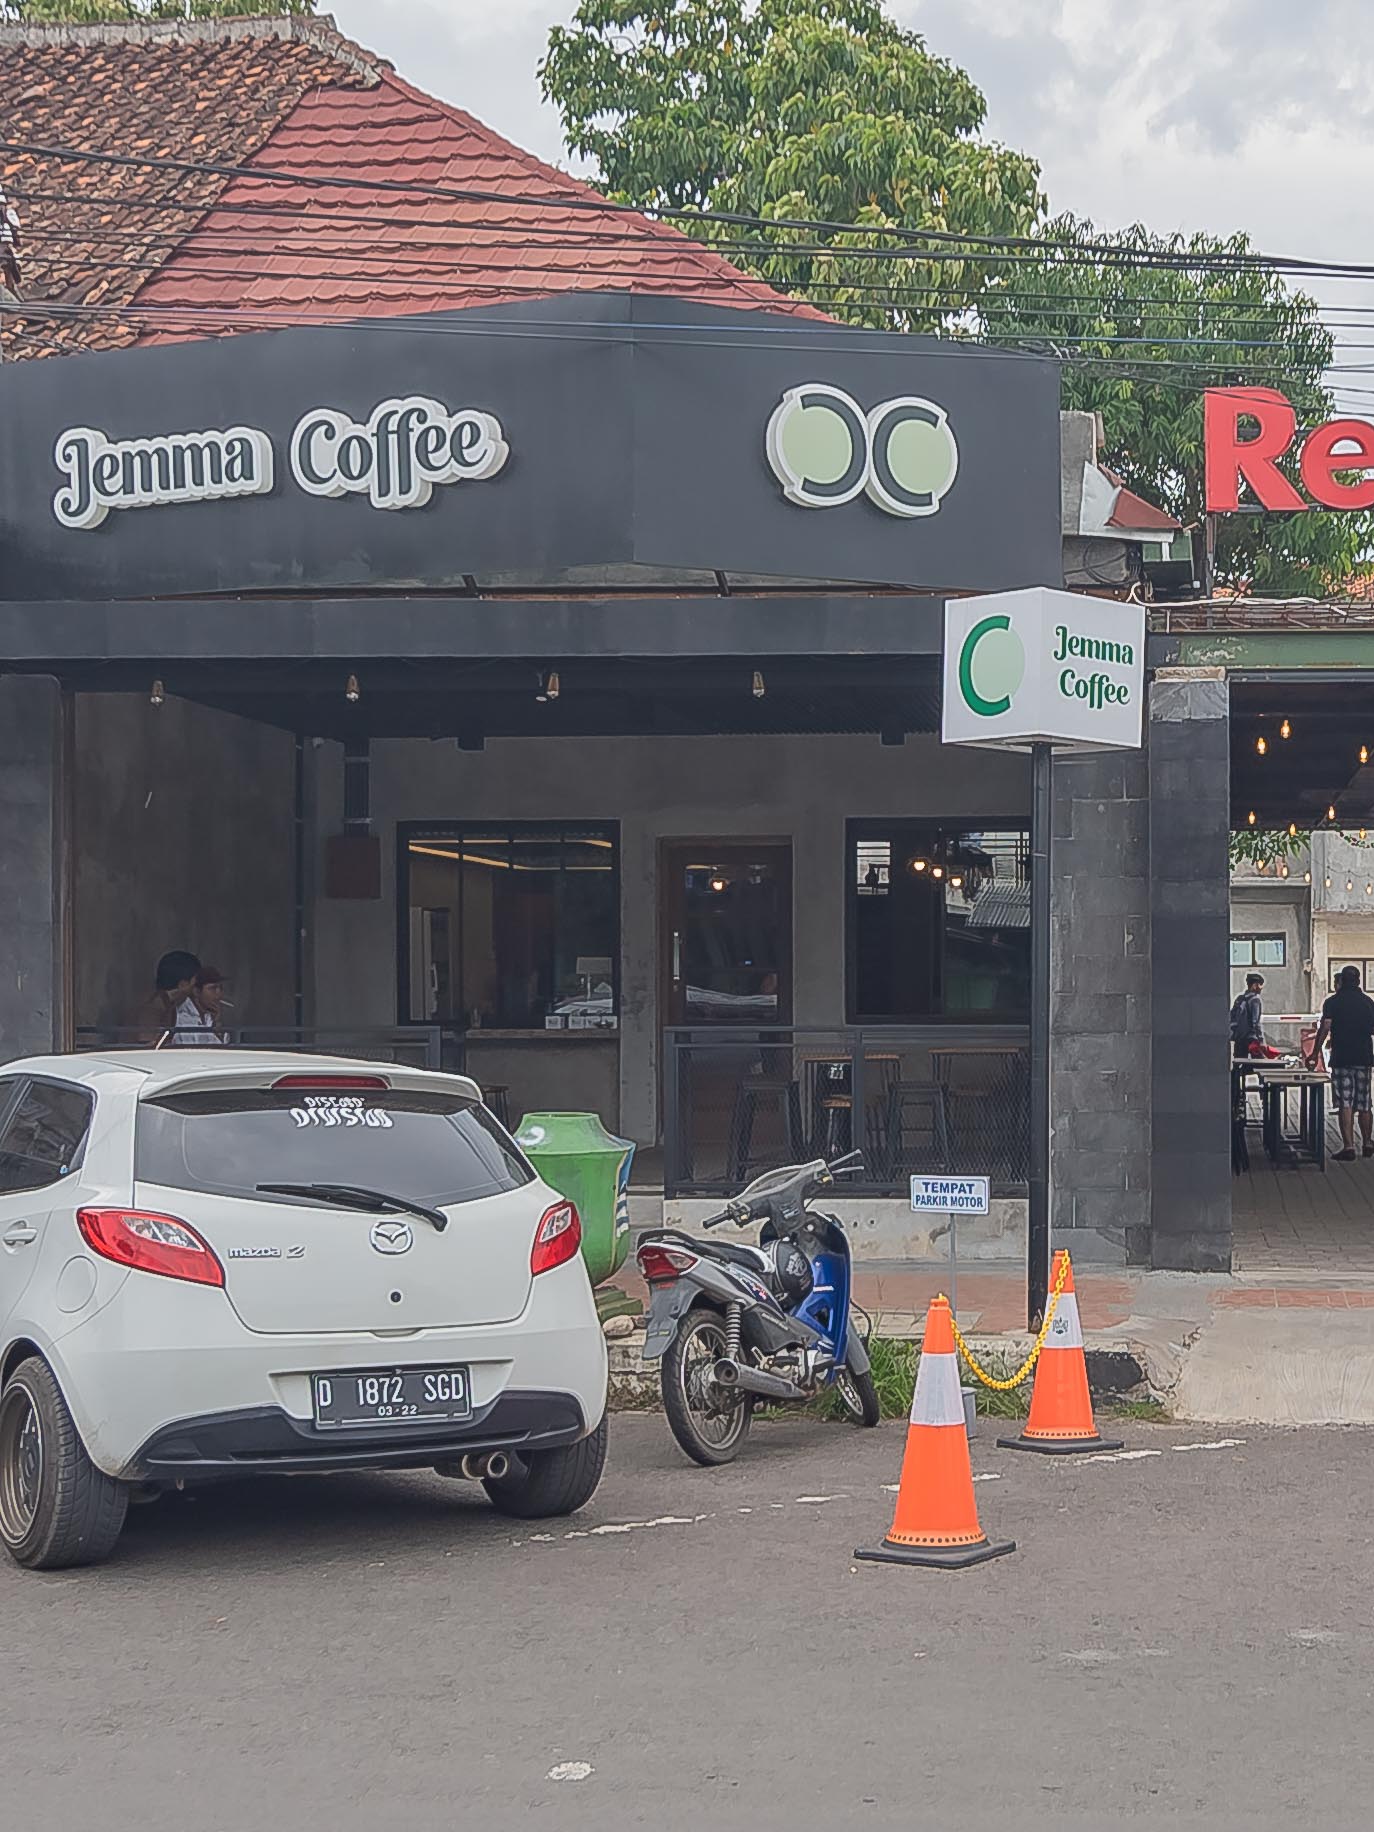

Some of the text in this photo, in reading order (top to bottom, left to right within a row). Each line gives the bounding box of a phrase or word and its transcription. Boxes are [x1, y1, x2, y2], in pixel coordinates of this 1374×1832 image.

[57, 400, 499, 524] Jemma Coffee
[1053, 625, 1134, 666] Jemma
[1059, 668, 1131, 710] Coffee
[915, 1194, 984, 1208] PARKIR MOTOR
[921, 1181, 975, 1195] TEMPAT
[228, 1246, 282, 1258] mazda
[318, 1373, 464, 1407] D 1872 SGD
